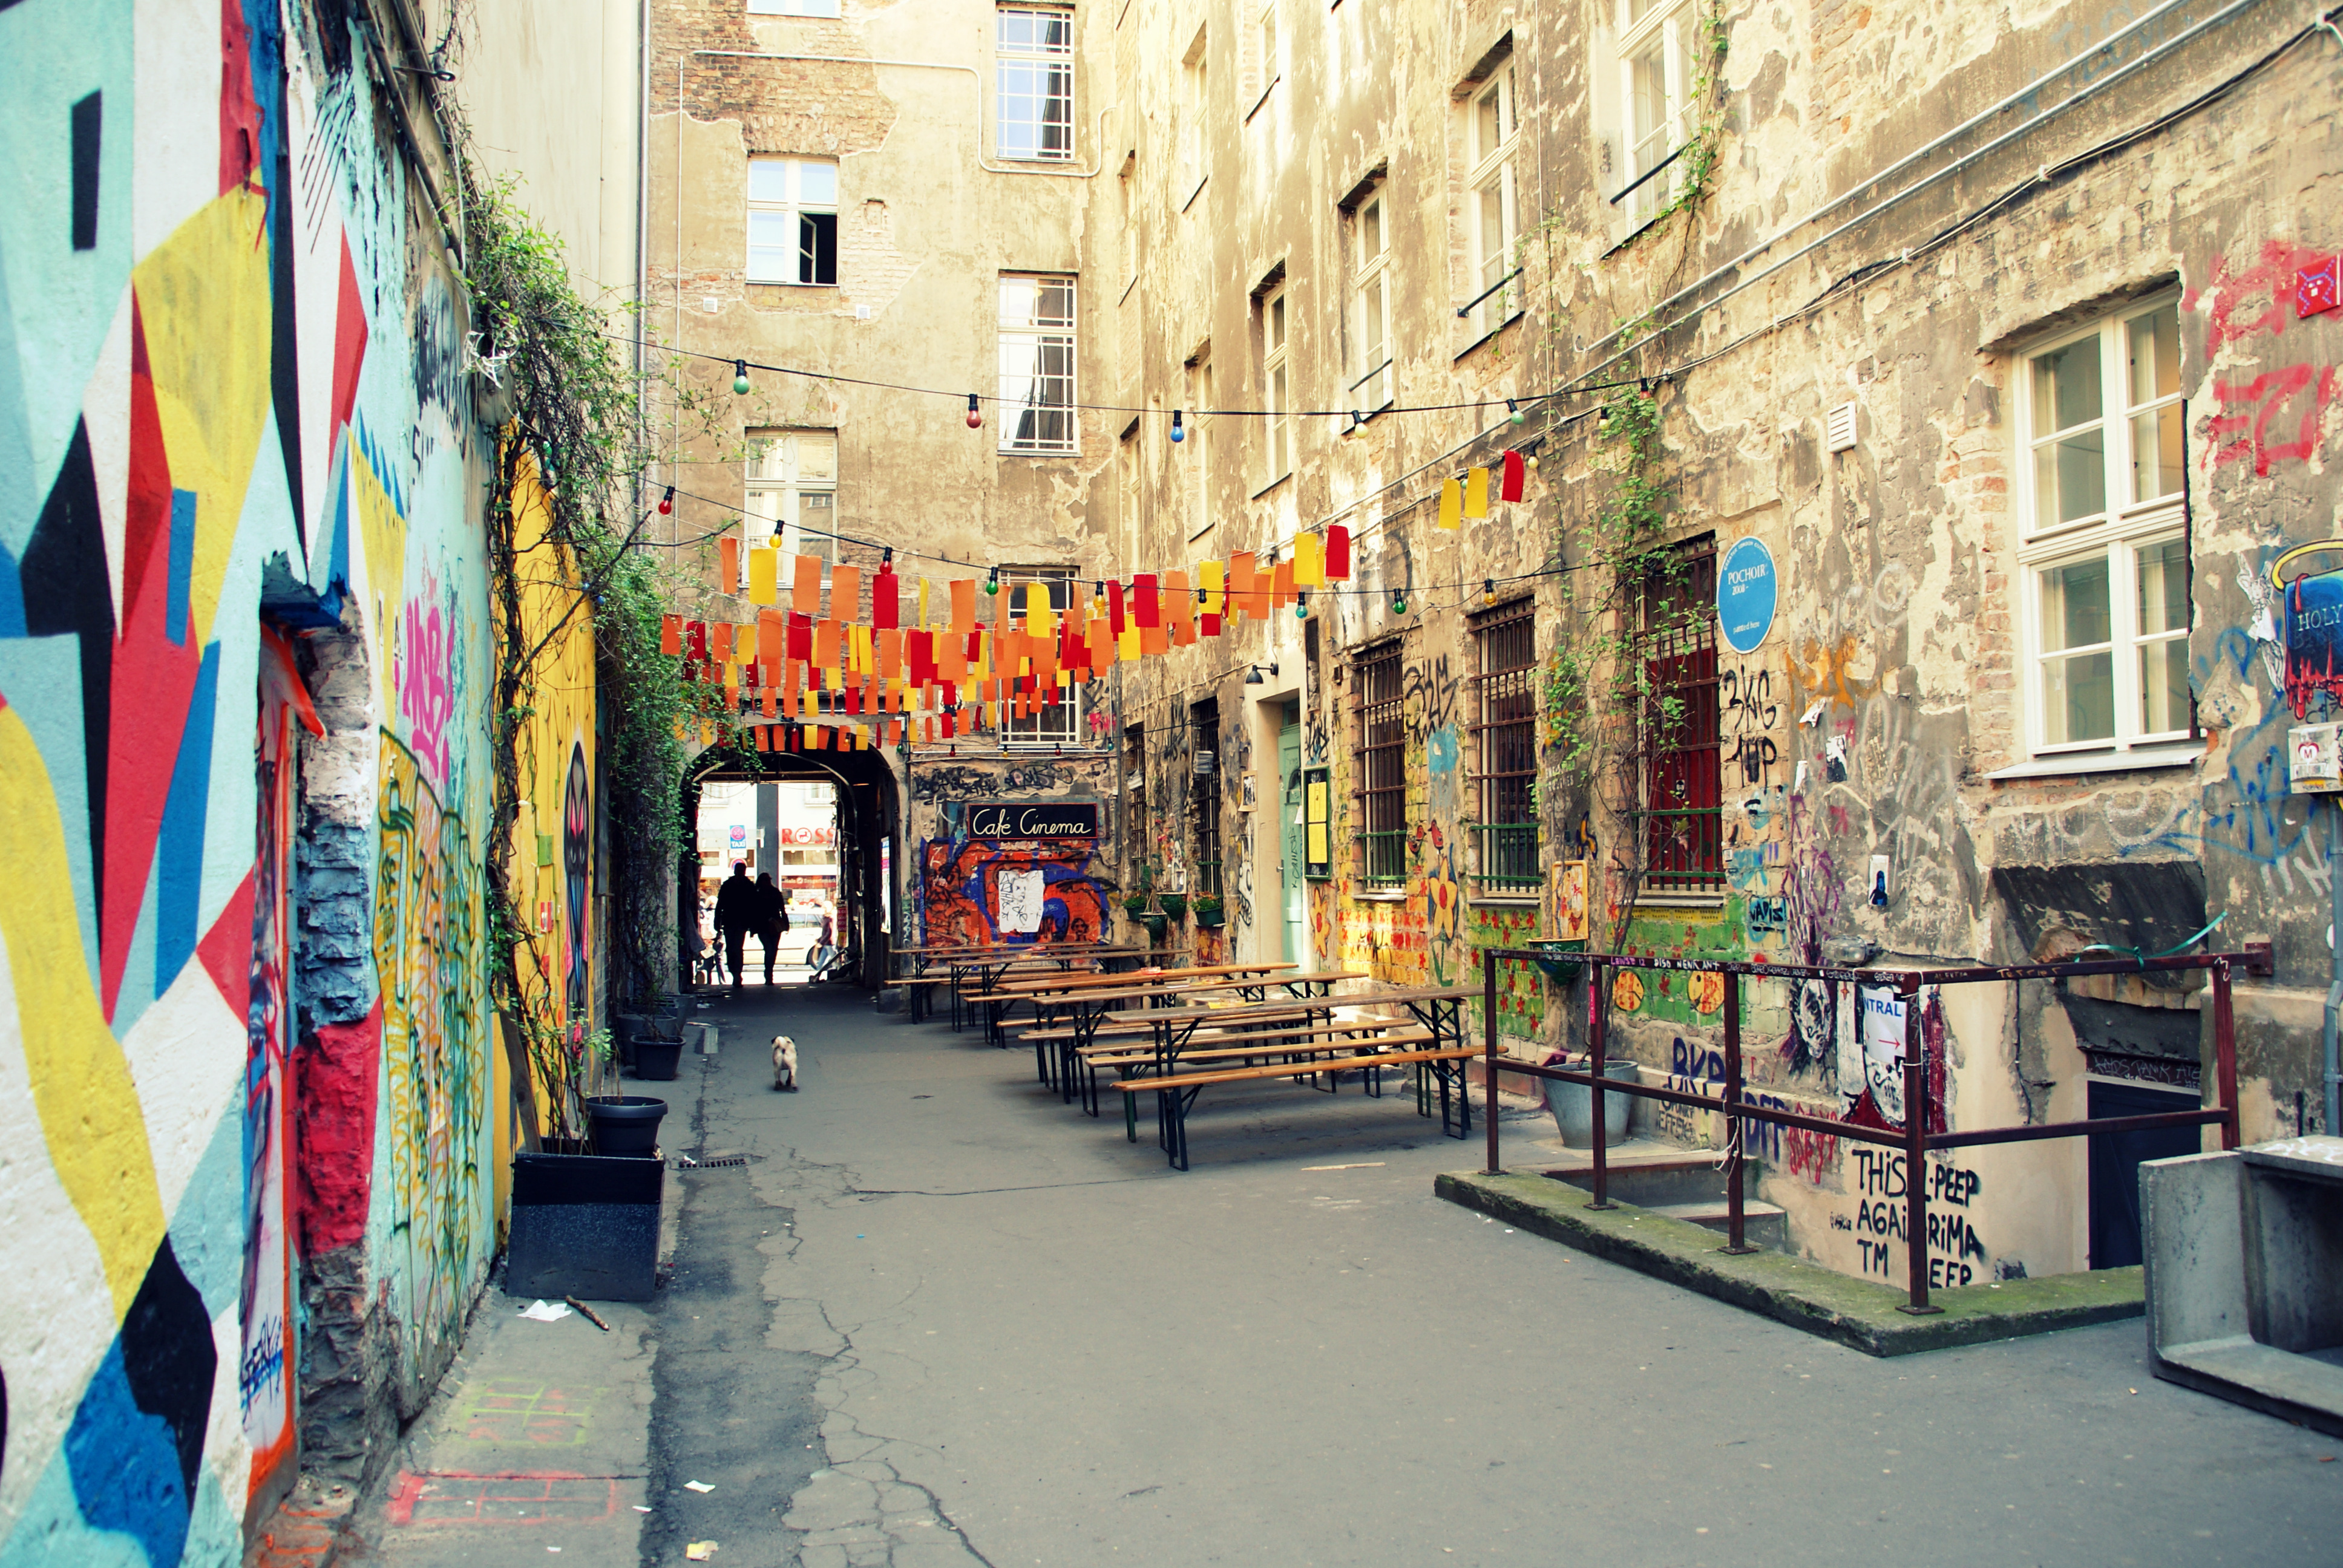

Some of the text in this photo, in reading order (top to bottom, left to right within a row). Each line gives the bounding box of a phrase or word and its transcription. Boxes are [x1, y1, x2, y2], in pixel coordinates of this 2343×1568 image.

[2298, 604, 2343, 632] HOLY
[972, 808, 1092, 839] Café Cinema
[731, 840, 746, 848] TAXI
